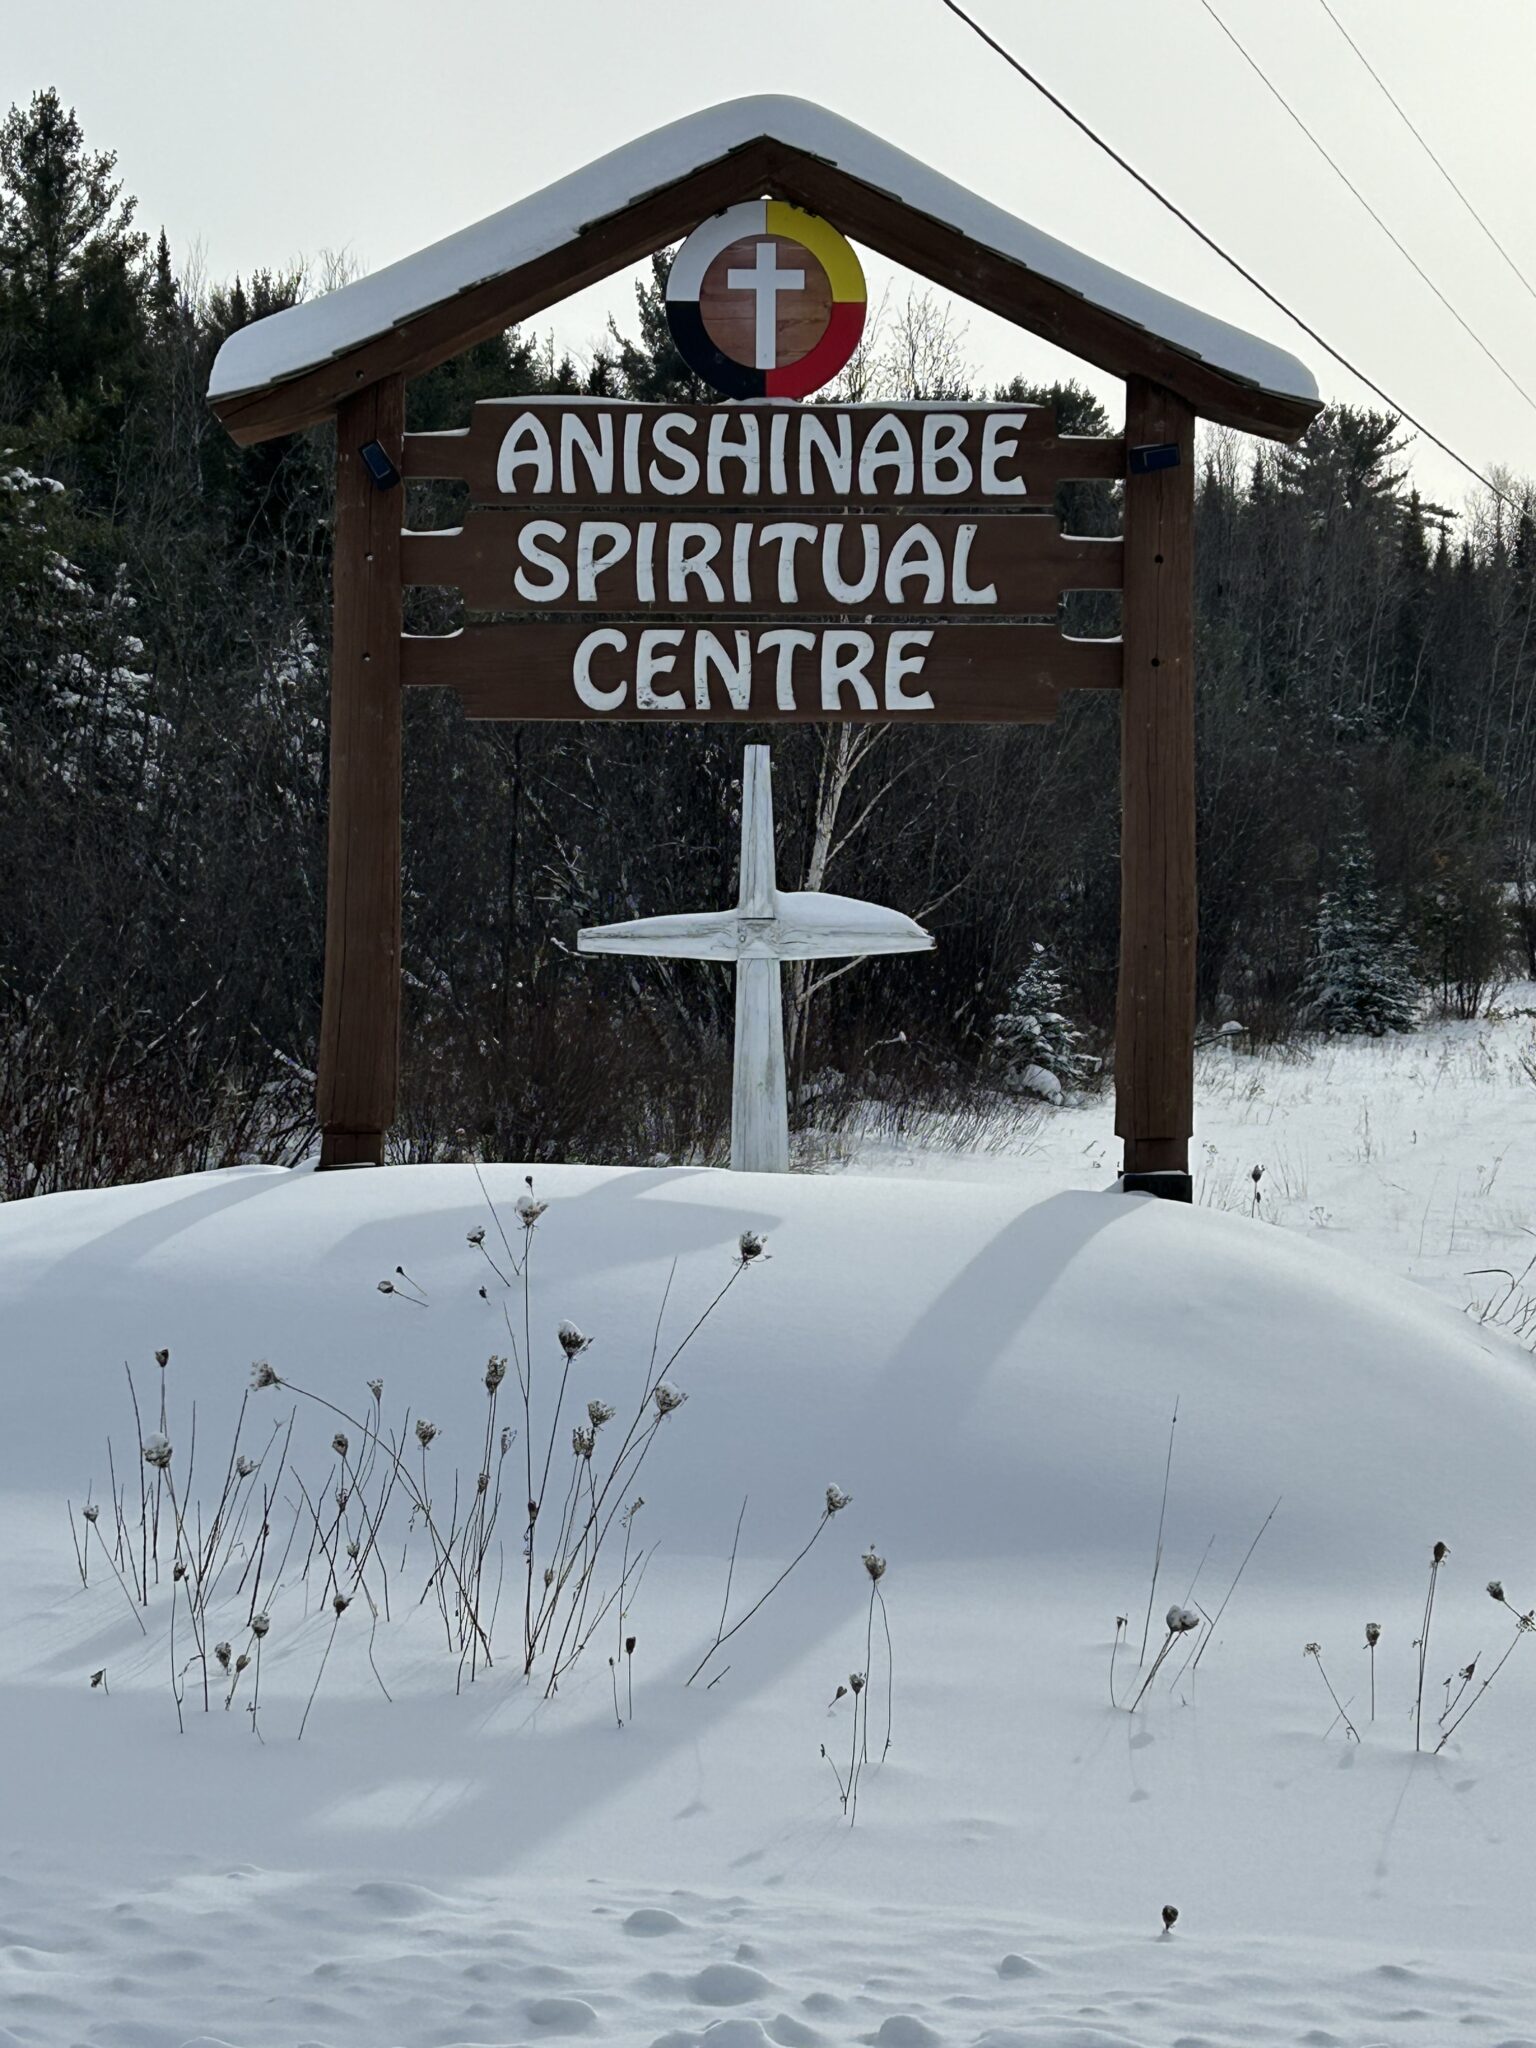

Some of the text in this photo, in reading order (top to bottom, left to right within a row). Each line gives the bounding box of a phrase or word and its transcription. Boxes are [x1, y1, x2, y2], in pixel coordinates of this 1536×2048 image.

[497, 412, 1027, 495] ANISHINABE
[514, 521, 997, 604] SPIRITUAL
[573, 629, 935, 711] CENTRE
